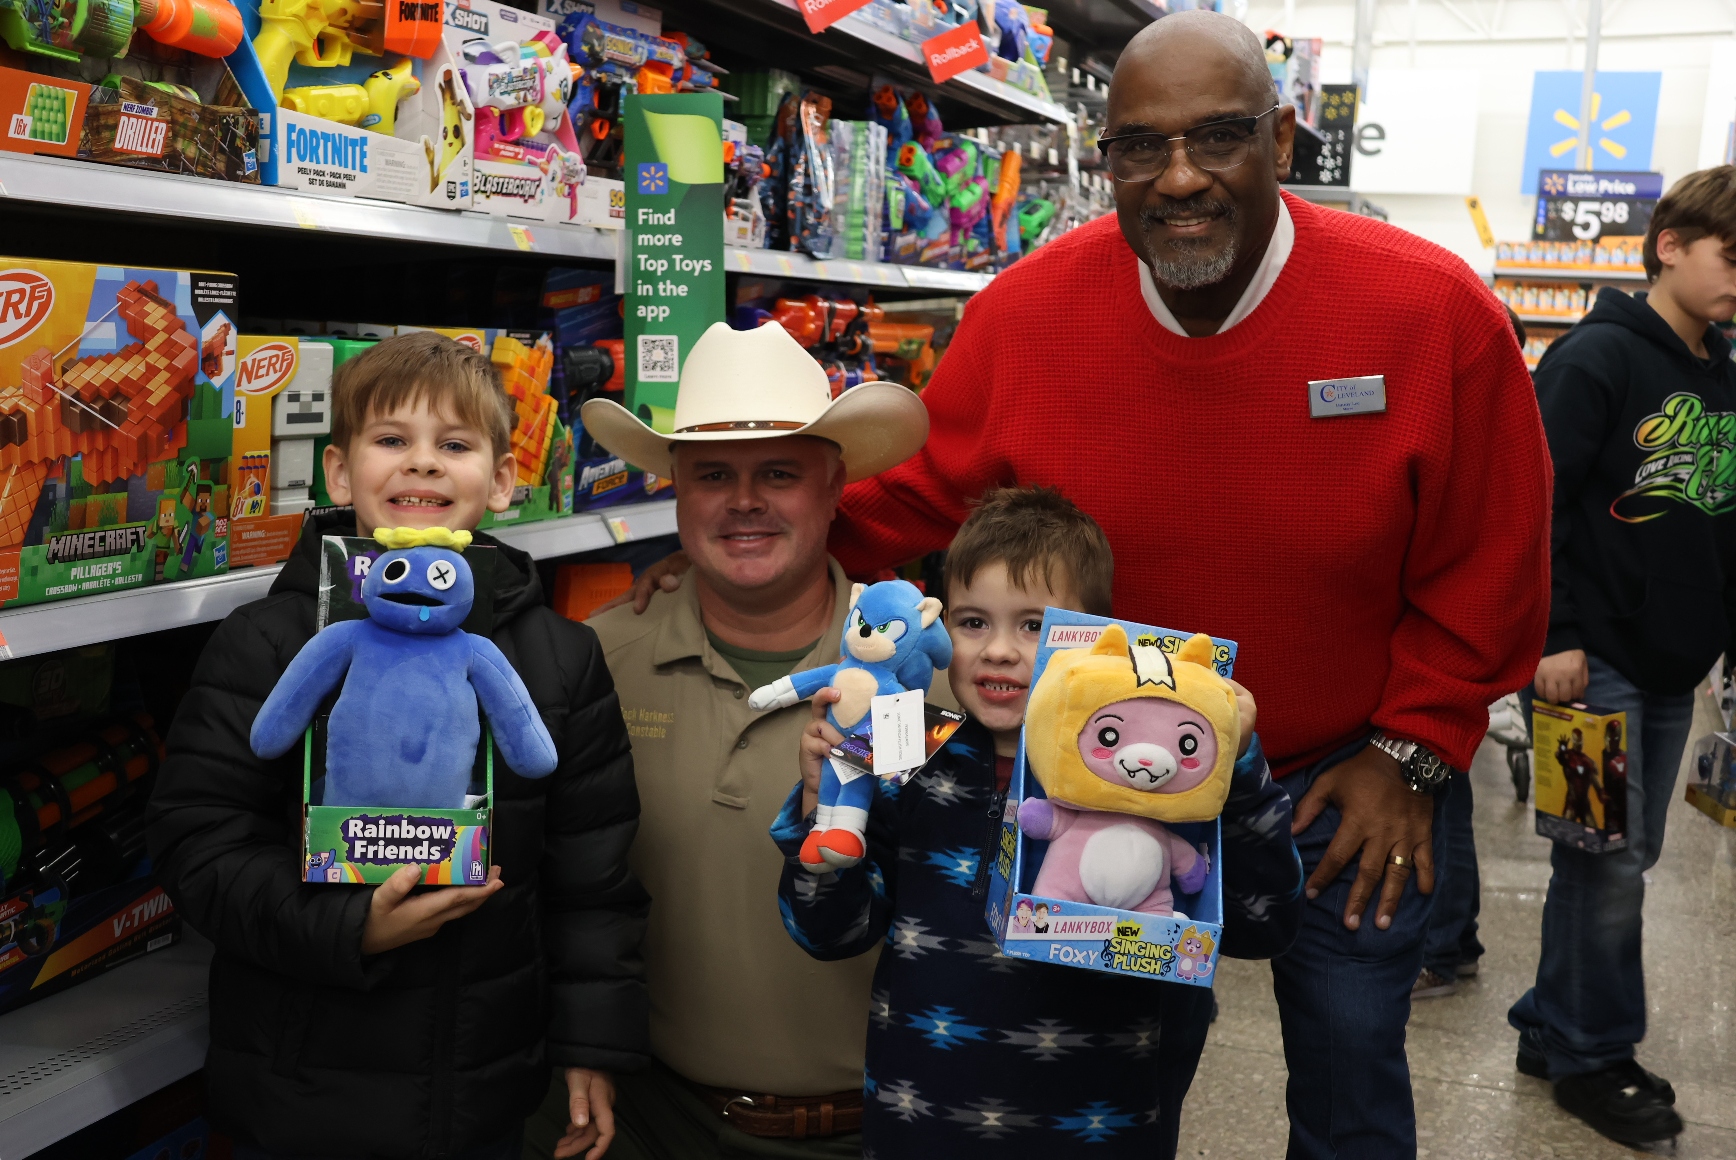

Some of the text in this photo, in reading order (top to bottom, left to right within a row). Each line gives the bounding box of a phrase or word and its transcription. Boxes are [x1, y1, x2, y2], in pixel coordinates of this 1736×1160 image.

[399, 1, 439, 23] FORTNITE
[930, 38, 981, 67] Rollback
[123, 102, 154, 116] NERF ZOMBIE
[114, 116, 167, 155] DRILLER
[286, 123, 368, 174] FORTNITE
[297, 166, 356, 182] PEELY PACK PACK PEELY
[308, 177, 319, 186] SET
[474, 169, 542, 201] BLASTERCORN
[1567, 178, 1637, 195] Low Price
[638, 208, 676, 225] Find
[638, 233, 683, 247] more
[637, 254, 712, 276] Top Toys
[637, 280, 689, 297] in the
[637, 305, 671, 322] app
[236, 350, 294, 389] NERF
[1635, 458, 1667, 484] LOVE
[47, 526, 147, 564] MINECRAFT
[71, 562, 122, 580] PILLAGER'S
[45, 584, 78, 596] CROSSBOW
[348, 819, 452, 840] Rainbow
[354, 840, 441, 860] Friends
[1053, 921, 1140, 937] LANKYBOX NEW
[1048, 937, 1173, 966] FOXY SINGING
[1112, 953, 1162, 975] PLUSH
